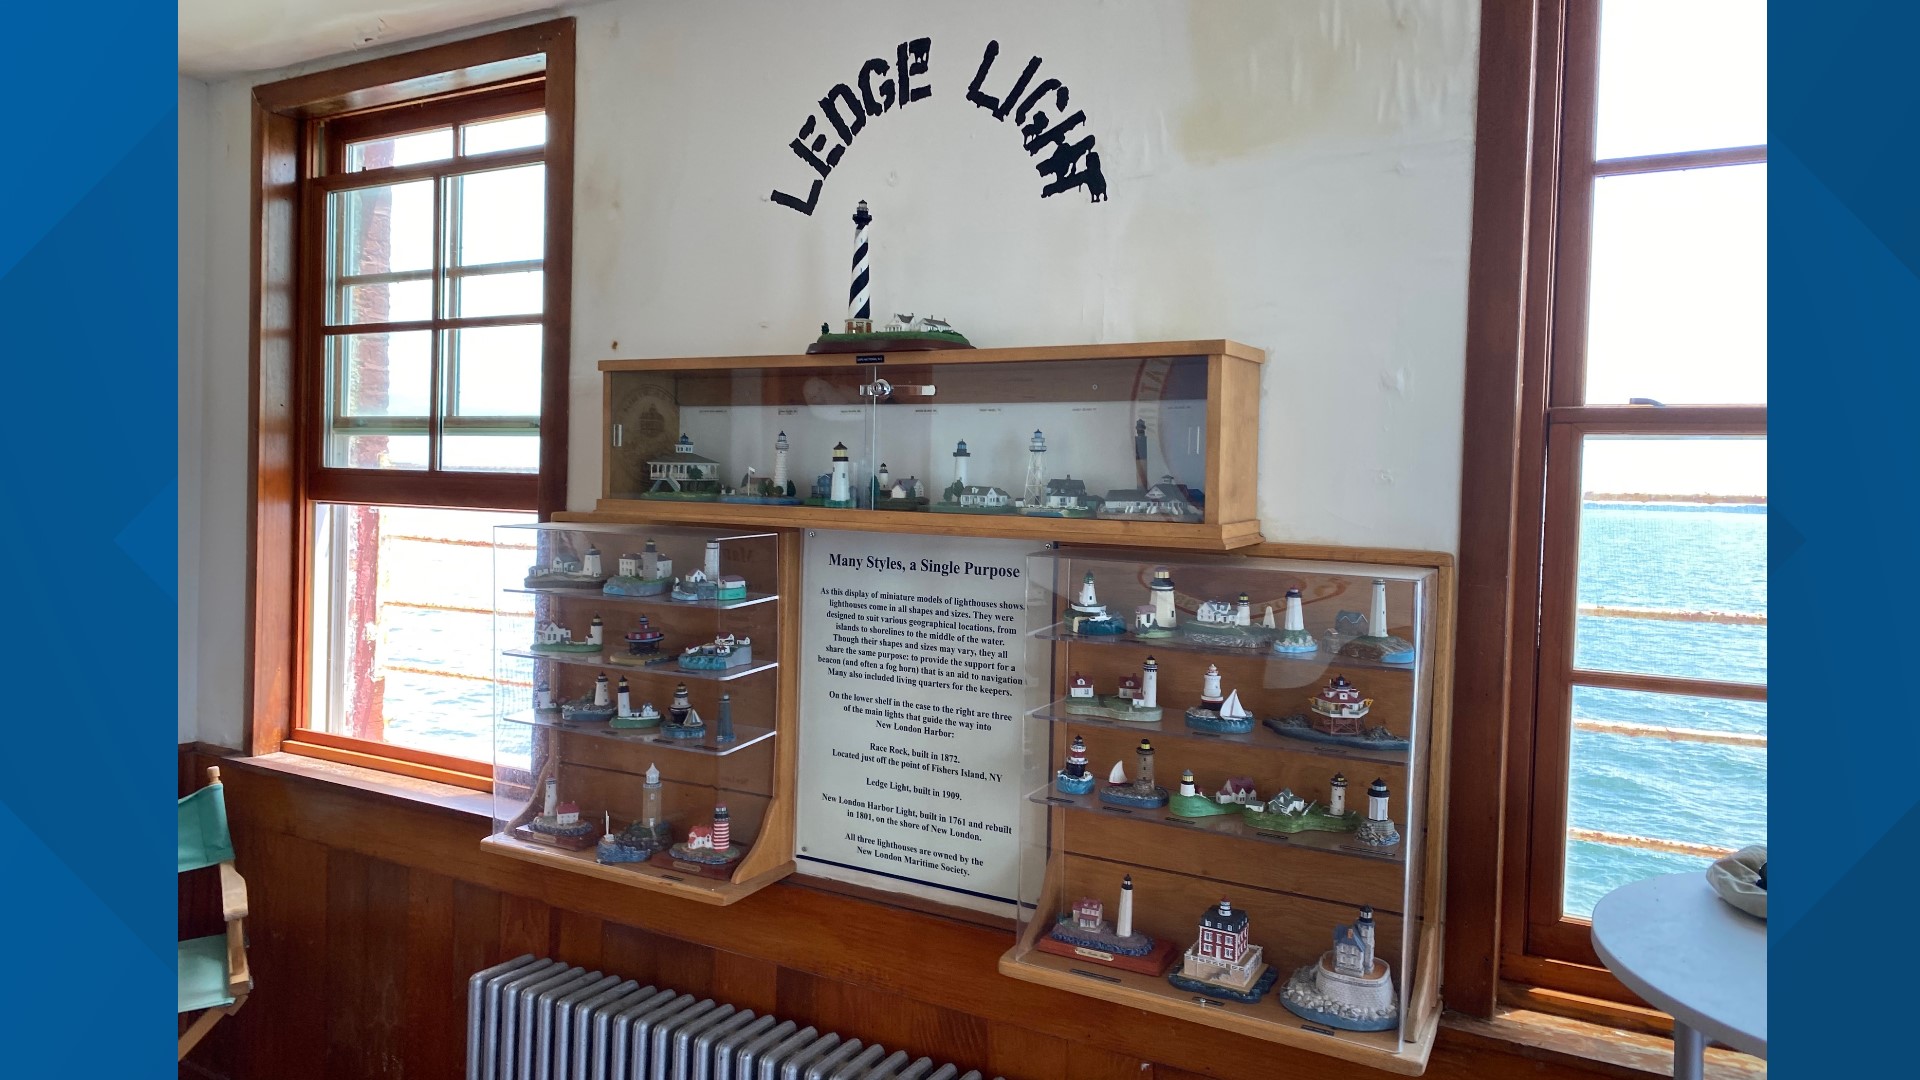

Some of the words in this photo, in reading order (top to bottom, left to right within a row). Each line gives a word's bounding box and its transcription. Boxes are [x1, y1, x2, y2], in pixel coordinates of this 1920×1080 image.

[770, 37, 932, 217] LEDGE
[965, 39, 1108, 203] LIGHT
[828, 553, 864, 571] Many
[866, 556, 906, 573] Styles,
[909, 561, 917, 571] a
[920, 559, 961, 577] Single
[964, 562, 1021, 581] Purpose
[820, 587, 830, 595] As
[830, 587, 844, 596] this
[844, 588, 870, 600] display
[870, 590, 879, 599] of
[879, 591, 916, 602] miniature
[916, 595, 943, 605] models
[944, 596, 954, 605] of
[954, 597, 998, 609] lighthouses
[829, 598, 868, 610] lighthouses
[868, 604, 888, 612] come
[889, 603, 896, 612] in
[897, 604, 907, 613] all
[908, 605, 934, 617] shapes
[935, 608, 950, 617] and
[972, 610, 993, 623] They
[994, 614, 1015, 622] were
[826, 610, 856, 621] designed
[865, 614, 880, 622] suit
[880, 615, 908, 625] various
[908, 619, 957, 630] geographical
[997, 625, 1017, 635] from
[835, 622, 860, 632] islands
[860, 625, 868, 633] to
[869, 625, 905, 637] shorelines
[906, 630, 914, 638] to
[915, 630, 928, 639] the
[929, 631, 956, 642] middle
[956, 634, 966, 643] of
[966, 634, 979, 644] the
[825, 644, 845, 654] share
[845, 646, 857, 655] the
[857, 649, 877, 657] same
[910, 654, 919, 662] to
[920, 655, 949, 665] provide
[950, 657, 963, 667] the
[964, 660, 995, 671] support
[996, 662, 1010, 672] for
[832, 633, 860, 646] Though
[860, 636, 878, 646] their
[878, 638, 903, 650] shapes
[904, 641, 919, 650] and
[919, 642, 938, 652] sizes
[939, 646, 956, 656] may
[978, 648, 996, 660] they
[997, 650, 1008, 659] all
[817, 654, 841, 665] beacon
[842, 657, 859, 667] (and
[859, 659, 878, 669] often
[885, 662, 898, 674] fog
[898, 663, 920, 676] horn)
[920, 666, 936, 676] that
[937, 668, 944, 677] is
[945, 670, 956, 678] an
[956, 670, 969, 680] aid
[971, 673, 979, 681] to
[827, 667, 848, 679] Many
[848, 670, 863, 679] also
[864, 671, 895, 683] included
[896, 675, 917, 688] living
[918, 679, 951, 690] quarters
[951, 681, 964, 691] for
[965, 683, 979, 693] the
[828, 690, 840, 699] On
[841, 692, 853, 701] the
[853, 693, 874, 704] lower
[874, 696, 893, 706] shelf
[893, 698, 901, 707] in
[902, 699, 914, 709] the
[932, 704, 941, 713] to
[941, 705, 954, 714] the
[955, 706, 975, 718] right
[976, 711, 990, 719] are
[991, 711, 1013, 722] three
[843, 704, 852, 713] of
[852, 705, 864, 714] the
[864, 707, 884, 717] main
[884, 709, 905, 720] lights
[906, 712, 921, 722] that
[922, 715, 944, 725] guide
[944, 717, 957, 727] the
[958, 721, 975, 731] way
[976, 721, 992, 731] into
[875, 719, 892, 729] New
[893, 722, 922, 734] London
[869, 742, 888, 753] Race
[911, 748, 929, 759] built
[930, 751, 939, 761] in
[832, 748, 860, 760] Located
[860, 752, 875, 763] just
[876, 756, 888, 765] off
[888, 757, 900, 767] the
[900, 760, 921, 770] point
[921, 763, 931, 772] of
[931, 763, 959, 776] Fishers
[989, 772, 1003, 783] NY
[866, 776, 888, 790] Ledge
[913, 785, 931, 796] built
[932, 788, 940, 798] in
[822, 792, 837, 802] New
[838, 795, 866, 808] London
[867, 801, 895, 813] Harbor
[919, 810, 937, 821] built
[938, 813, 947, 823] in
[949, 815, 966, 827] 1761
[968, 821, 983, 829] and
[985, 822, 1012, 835] rebuilt
[847, 809, 854, 818] in
[875, 816, 885, 824] on
[886, 816, 899, 826] the
[899, 819, 920, 830] shore
[921, 823, 930, 832] of
[930, 824, 948, 835] New
[844, 832, 856, 842] All
[857, 834, 876, 845] three
[877, 838, 918, 854] lighthouses
[919, 848, 932, 857] are
[932, 851, 958, 862] owned
[958, 853, 970, 866] by
[971, 857, 984, 867] the
[857, 845, 873, 856] New
[874, 849, 903, 863] London
[903, 855, 939, 870] Maritime
